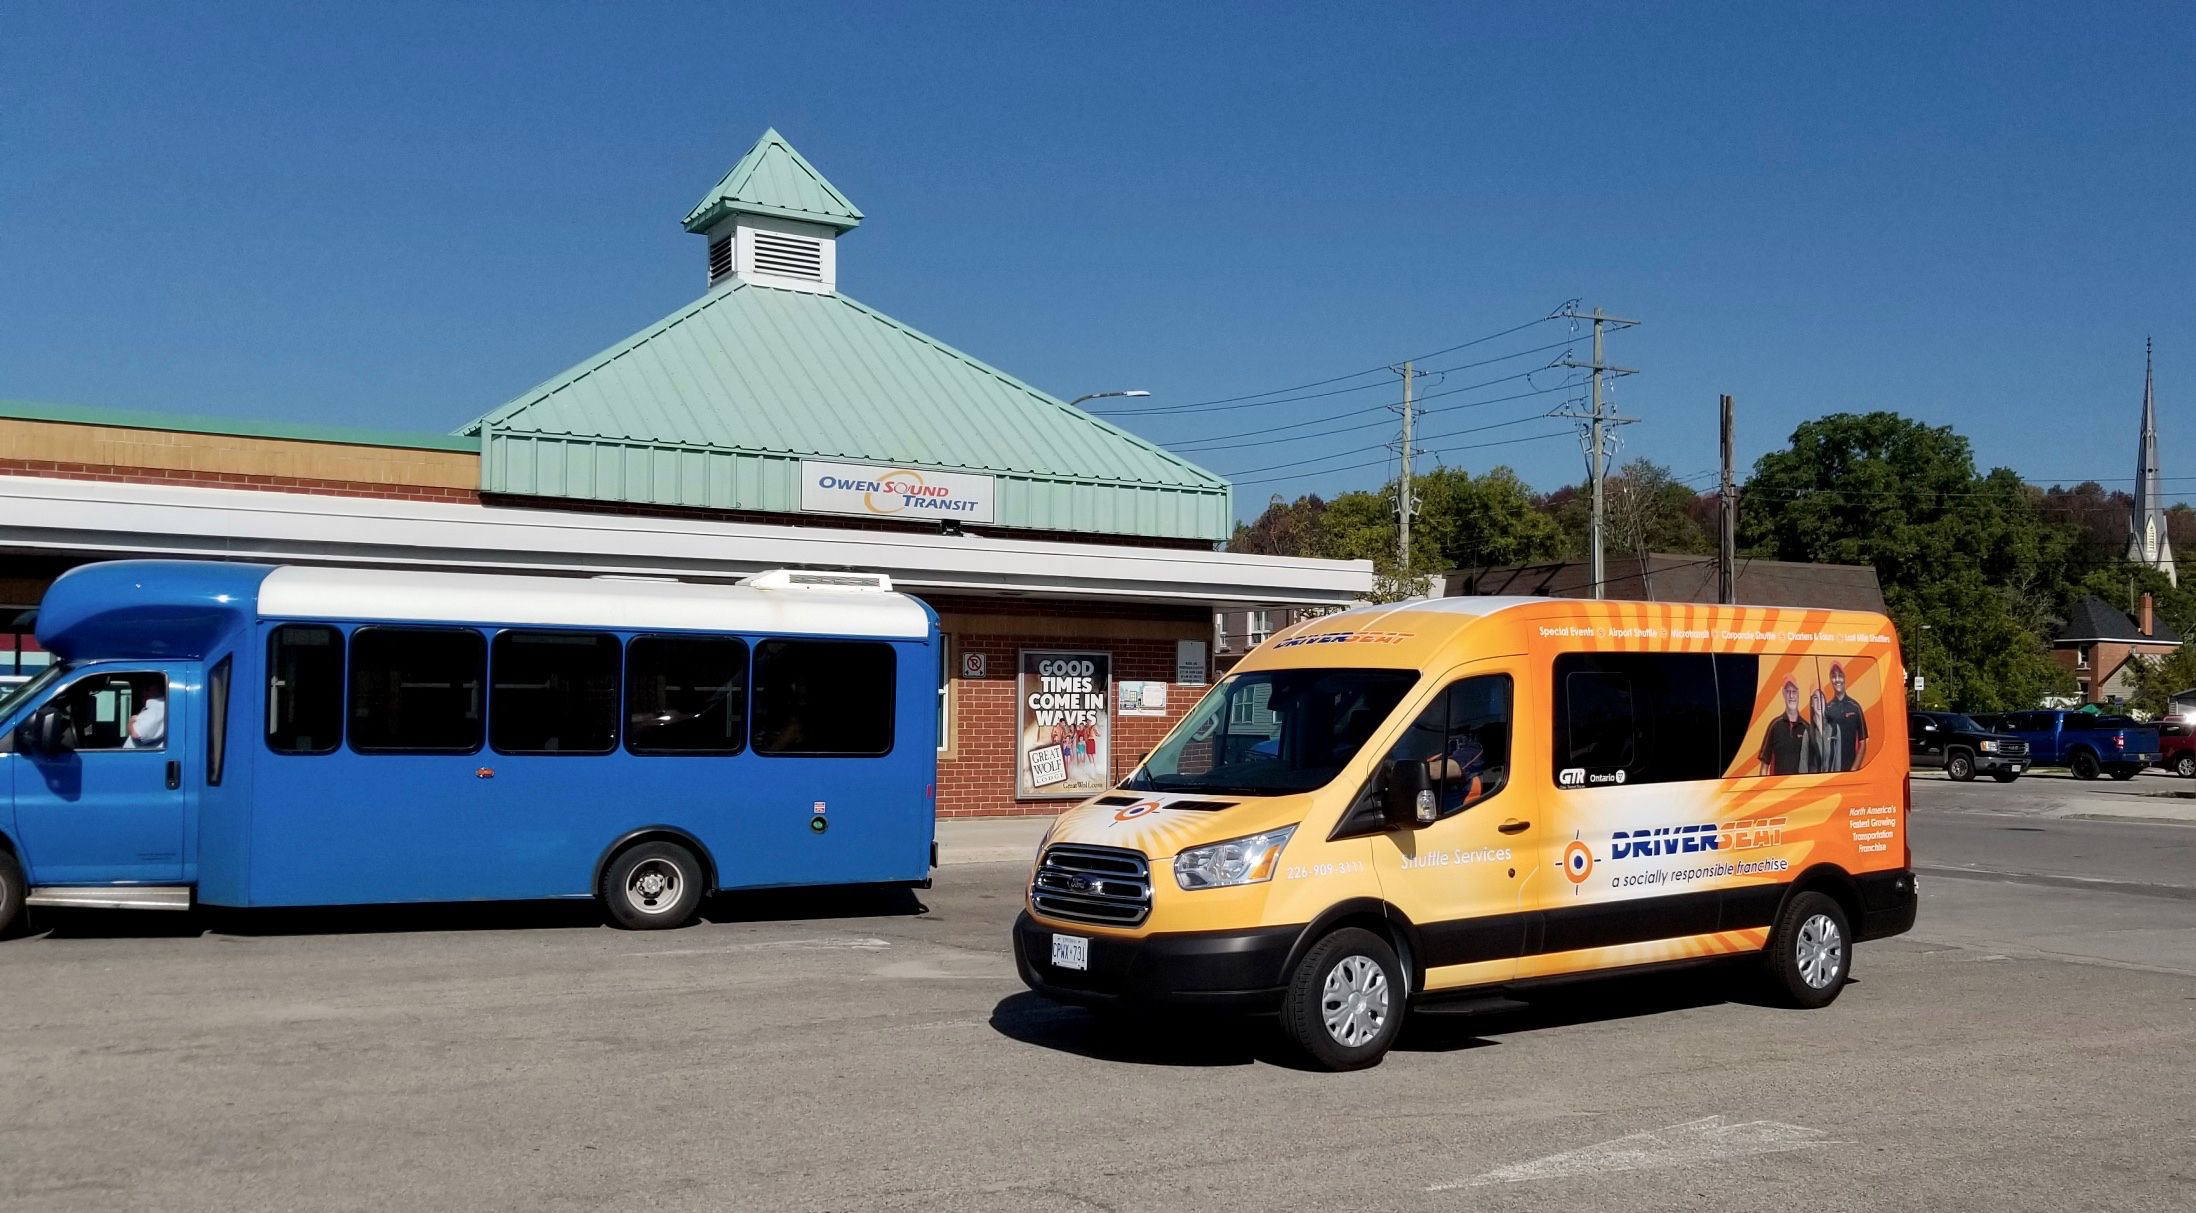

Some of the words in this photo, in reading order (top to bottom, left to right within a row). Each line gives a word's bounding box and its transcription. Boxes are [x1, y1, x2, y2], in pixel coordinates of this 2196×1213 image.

[819, 476, 880, 493] OWEN
[883, 481, 949, 497] SOUND
[903, 495, 978, 512] TRANSIT
[1539, 626, 1569, 638] Special
[1570, 627, 1594, 637] Events
[1608, 628, 1632, 638] Airport
[1633, 628, 1657, 638] Shuttle
[1722, 631, 1754, 641] Corporate
[1038, 660, 1094, 676] GOOD
[1041, 676, 1092, 693] TIMES
[1028, 693, 1083, 709] COME
[1084, 693, 1104, 709] IN
[1035, 710, 1097, 727] WAVES
[1032, 748, 1060, 763] GREAT
[1034, 759, 1062, 775] WOLF
[1036, 774, 1064, 783] LODGE
[1559, 768, 1585, 784] GTR
[1590, 773, 1615, 782] Ontario
[1849, 807, 1866, 816] North
[1867, 805, 1896, 814] America's
[1849, 819, 1869, 828] Fastest
[1871, 817, 1896, 828] Growing
[1612, 817, 1787, 860] DRIVERSEAT
[1852, 830, 1893, 841] Transportation
[1859, 842, 1887, 853] Franchise
[1401, 850, 1449, 870] Shuttle
[1455, 846, 1512, 865] Services
[1612, 877, 1620, 888] a
[1624, 868, 1669, 886] socially
[1671, 863, 1734, 882] responsible
[1736, 857, 1788, 876] franchise
